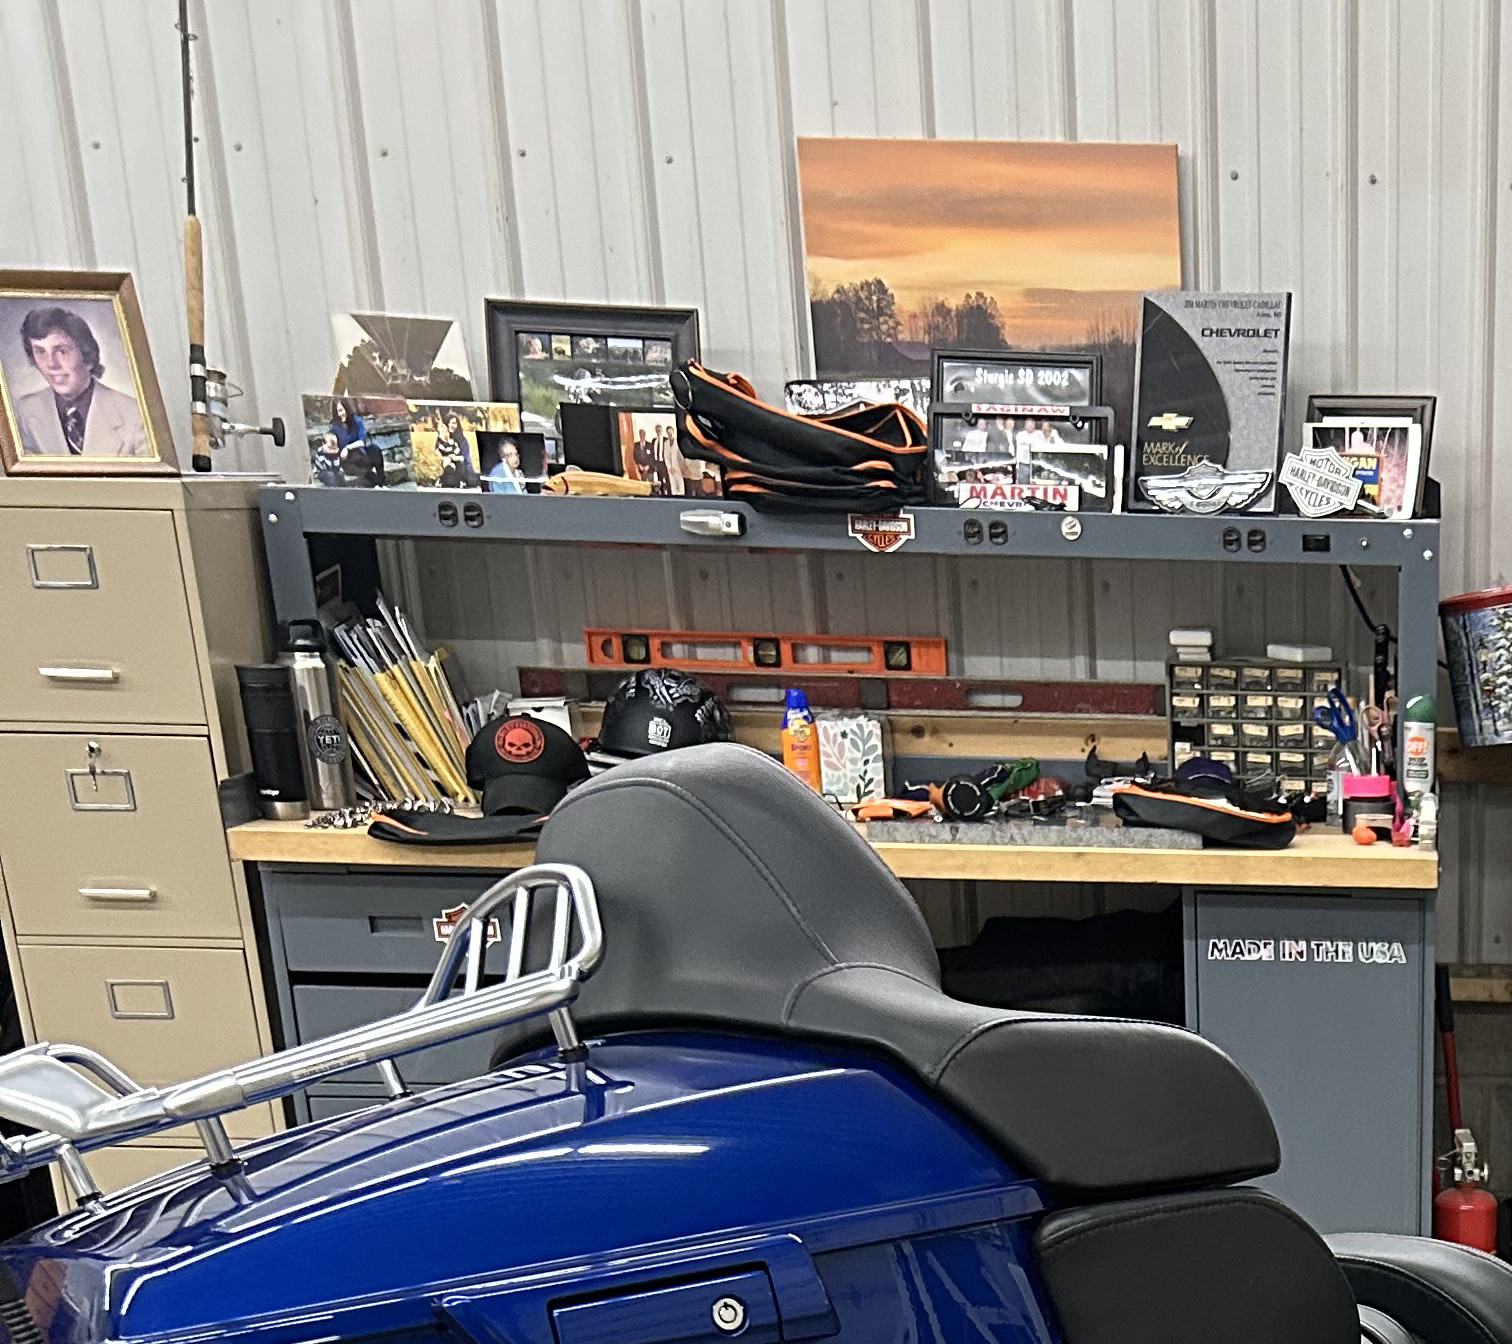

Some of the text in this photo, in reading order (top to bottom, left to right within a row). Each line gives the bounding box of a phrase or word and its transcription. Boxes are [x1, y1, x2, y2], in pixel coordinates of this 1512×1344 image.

[1201, 328, 1280, 338] CHEVROLET
[1017, 368, 1034, 386] SD
[1037, 370, 1069, 387] 2002
[976, 405, 1065, 414] SAGINAW
[1143, 442, 1175, 453] MARK
[1289, 465, 1352, 498] HARLEY-DAVIDSON
[970, 485, 1067, 502] MARTIN
[318, 735, 341, 744] YETI
[1208, 939, 1407, 963] MADE IN THE USA
